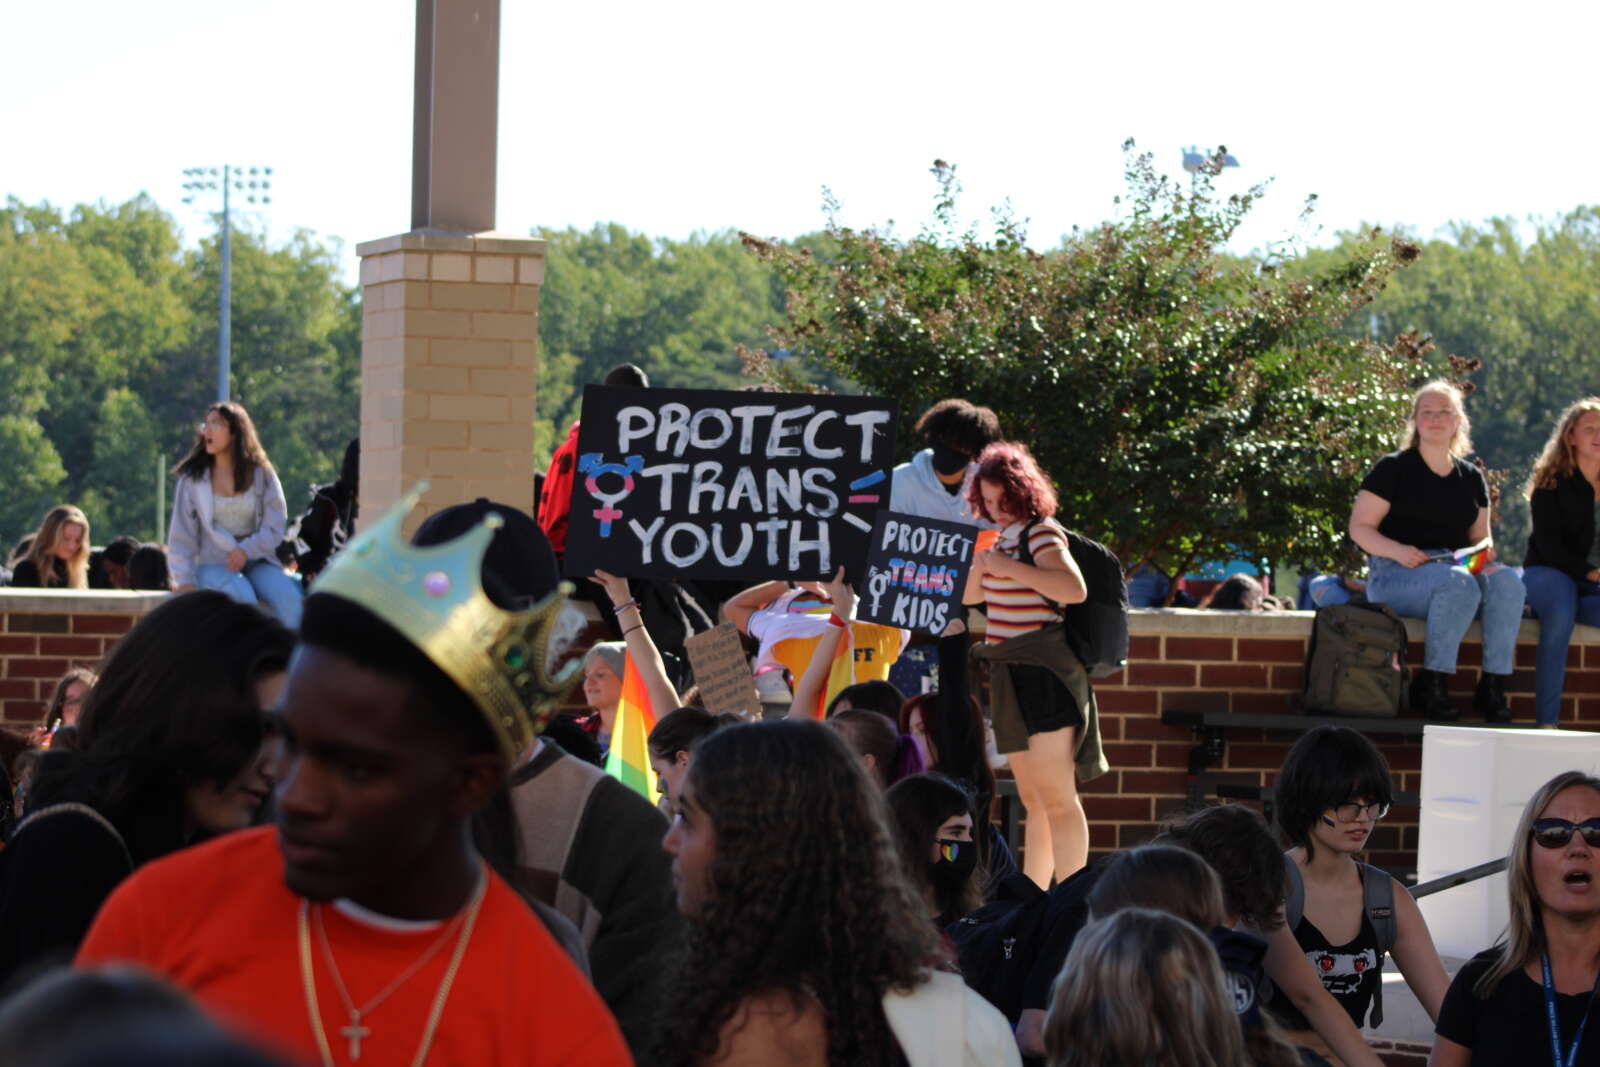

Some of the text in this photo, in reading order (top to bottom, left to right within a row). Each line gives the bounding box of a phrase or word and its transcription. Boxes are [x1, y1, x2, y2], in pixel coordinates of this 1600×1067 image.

[617, 403, 890, 463] PROTECT
[641, 461, 839, 518] TRANS
[628, 516, 831, 574] YOUTH
[882, 520, 974, 562] PROTECT
[889, 557, 958, 597] TRANS
[891, 592, 949, 635] KIDS
